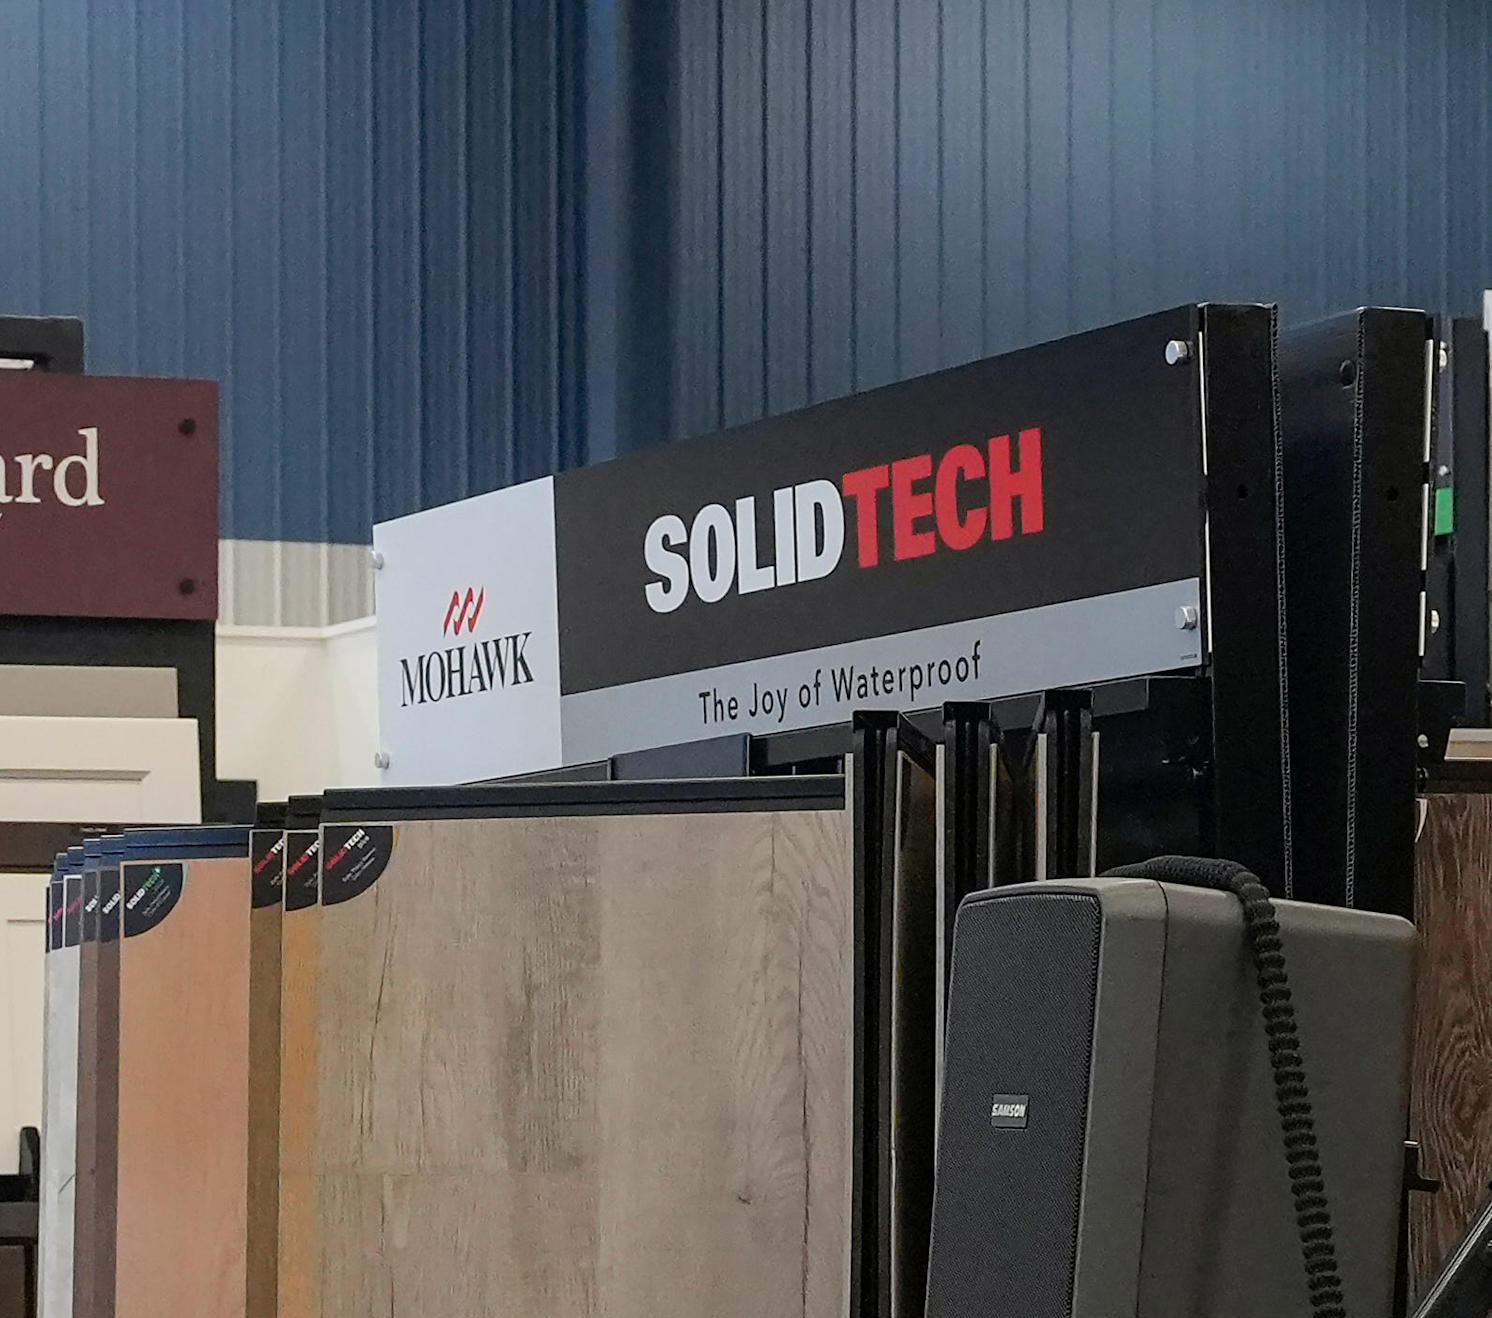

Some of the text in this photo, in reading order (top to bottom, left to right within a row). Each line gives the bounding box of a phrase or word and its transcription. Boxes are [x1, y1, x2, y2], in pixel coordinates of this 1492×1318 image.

[400, 631, 535, 707] MOHAWK
[698, 639, 982, 724] The Joy of Waterproof
[991, 1103, 1027, 1118] SAMSON
